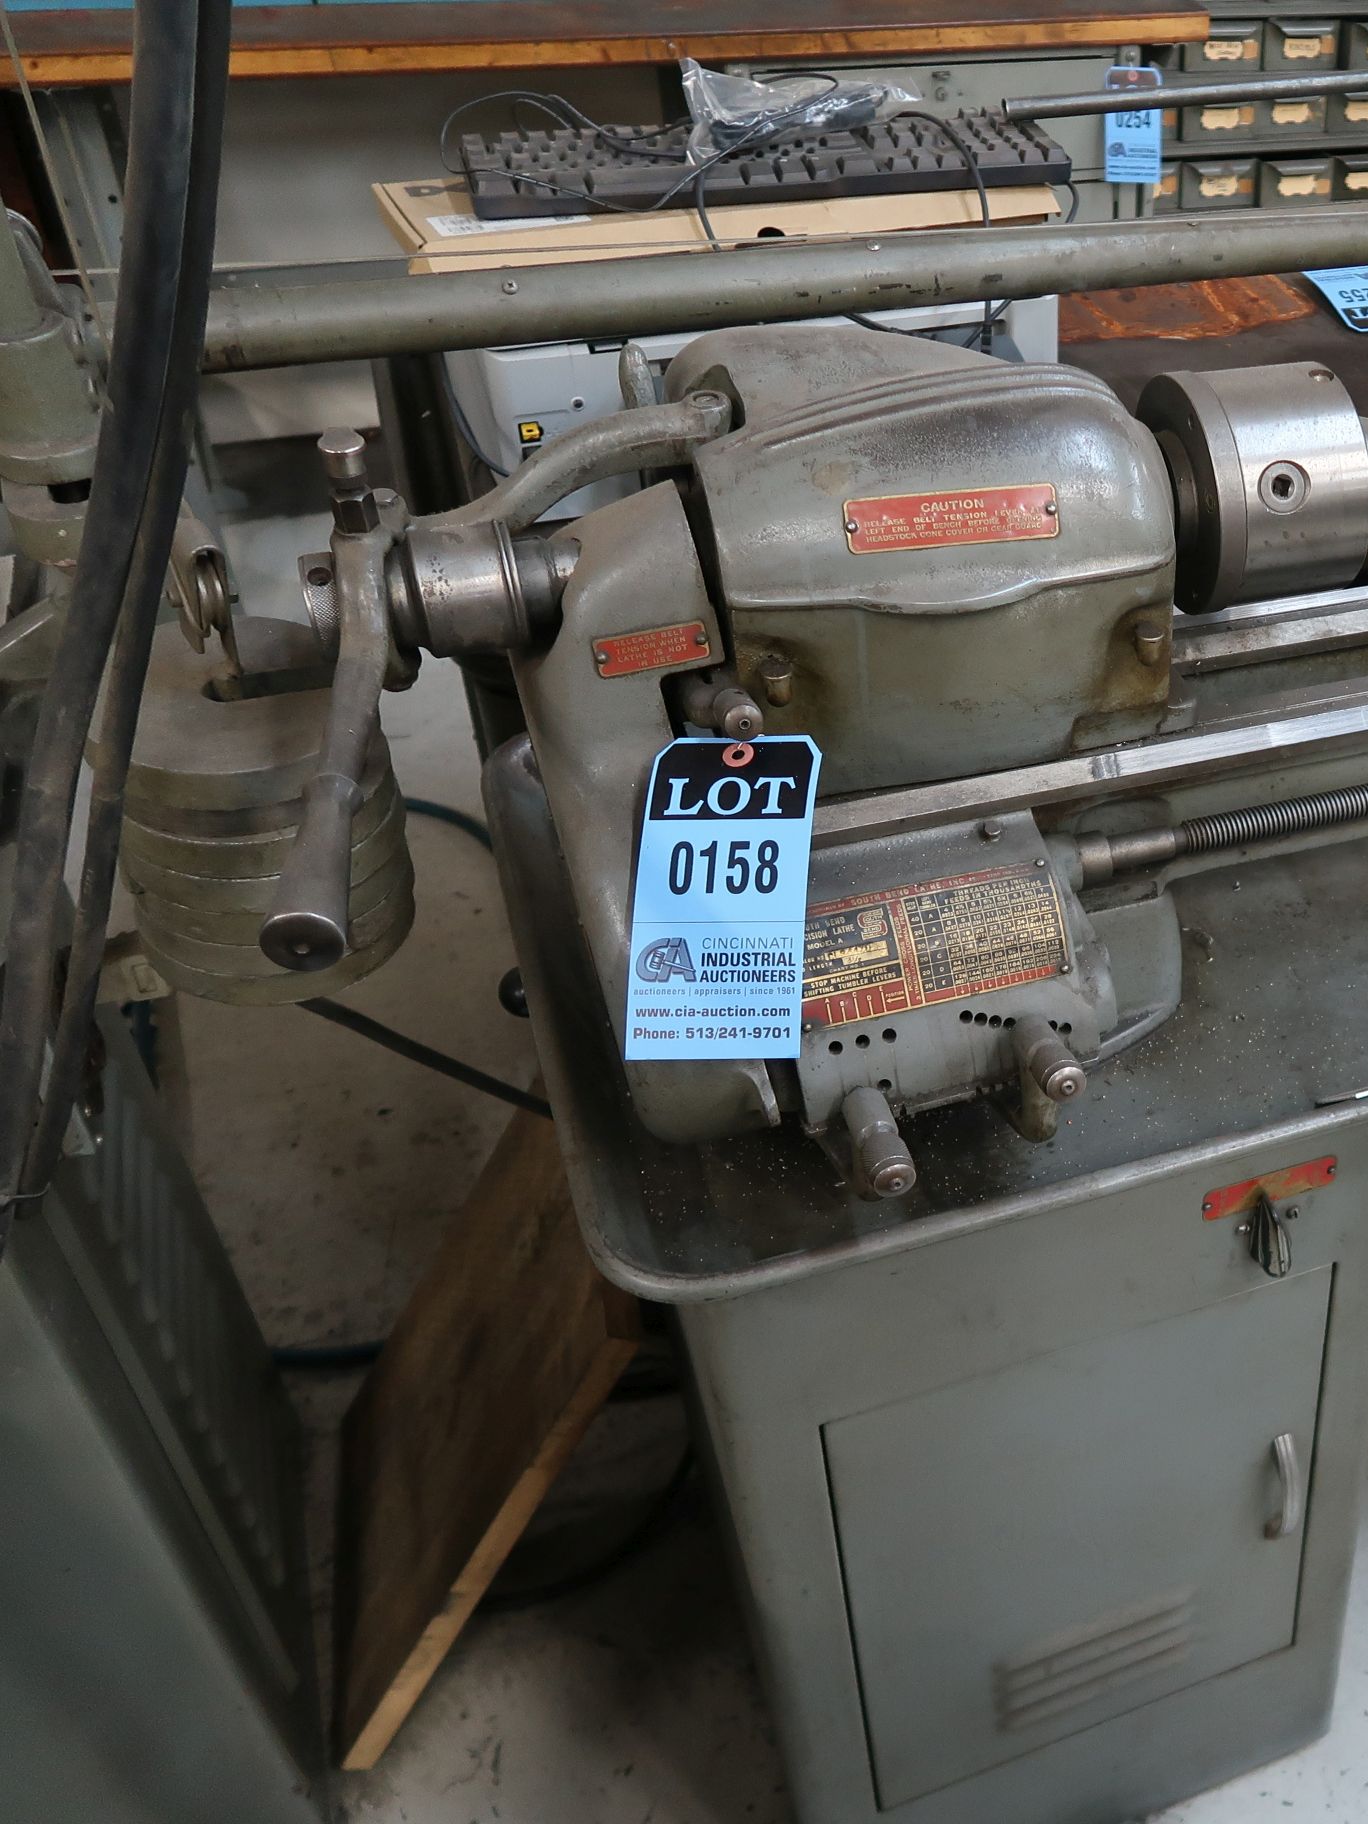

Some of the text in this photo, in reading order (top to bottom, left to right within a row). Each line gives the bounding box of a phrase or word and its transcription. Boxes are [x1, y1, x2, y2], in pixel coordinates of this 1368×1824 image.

[920, 499, 984, 513] CAUTION
[864, 517, 906, 529] RELEASE
[913, 513, 936, 523] BELT
[943, 511, 987, 521] TENSION
[864, 527, 886, 536] LEFT
[892, 525, 910, 534] END
[916, 523, 928, 532] OF
[967, 518, 1000, 528] BEFORE
[864, 532, 917, 544] HEADSTOCK
[946, 527, 975, 537] COVER
[977, 526, 989, 534] OR
[614, 629, 683, 647] RELEASE BELT
[616, 636, 686, 655] TENSION WHEN
[617, 652, 647, 663] LATHE
[669, 644, 687, 653] NOT
[653, 656, 672, 664] USE
[663, 776, 797, 816] LOT
[668, 840, 779, 895] 0158
[851, 895, 881, 906] SOUTH
[885, 888, 909, 899] BEND
[944, 893, 971, 904] FEEDS
[973, 890, 982, 899] IN
[984, 880, 1042, 896] THOUSANDTHS
[953, 885, 991, 896] THREADS
[825, 916, 846, 927] BEND
[896, 903, 904, 924] FEEDS
[833, 924, 855, 935] LATHE
[894, 916, 902, 938] FEEDS
[702, 937, 793, 950] CINCINNATI
[807, 940, 836, 950] MODEL
[900, 941, 908, 963] CROSS
[901, 926, 915, 973] LONGITUDINAL
[701, 952, 797, 967] INDUSTRIAL
[700, 969, 797, 983] AUCTIONEERS
[804, 972, 897, 997] SHIFTING TUMBLER LEVERS
[811, 967, 888, 989] STOP MACHINE BEFORE
[633, 986, 797, 998] auctioneers appraisers since 1961
[635, 1005, 791, 1018] www.cia-auction.com
[633, 1026, 791, 1040] Phone: 513/241-9701
